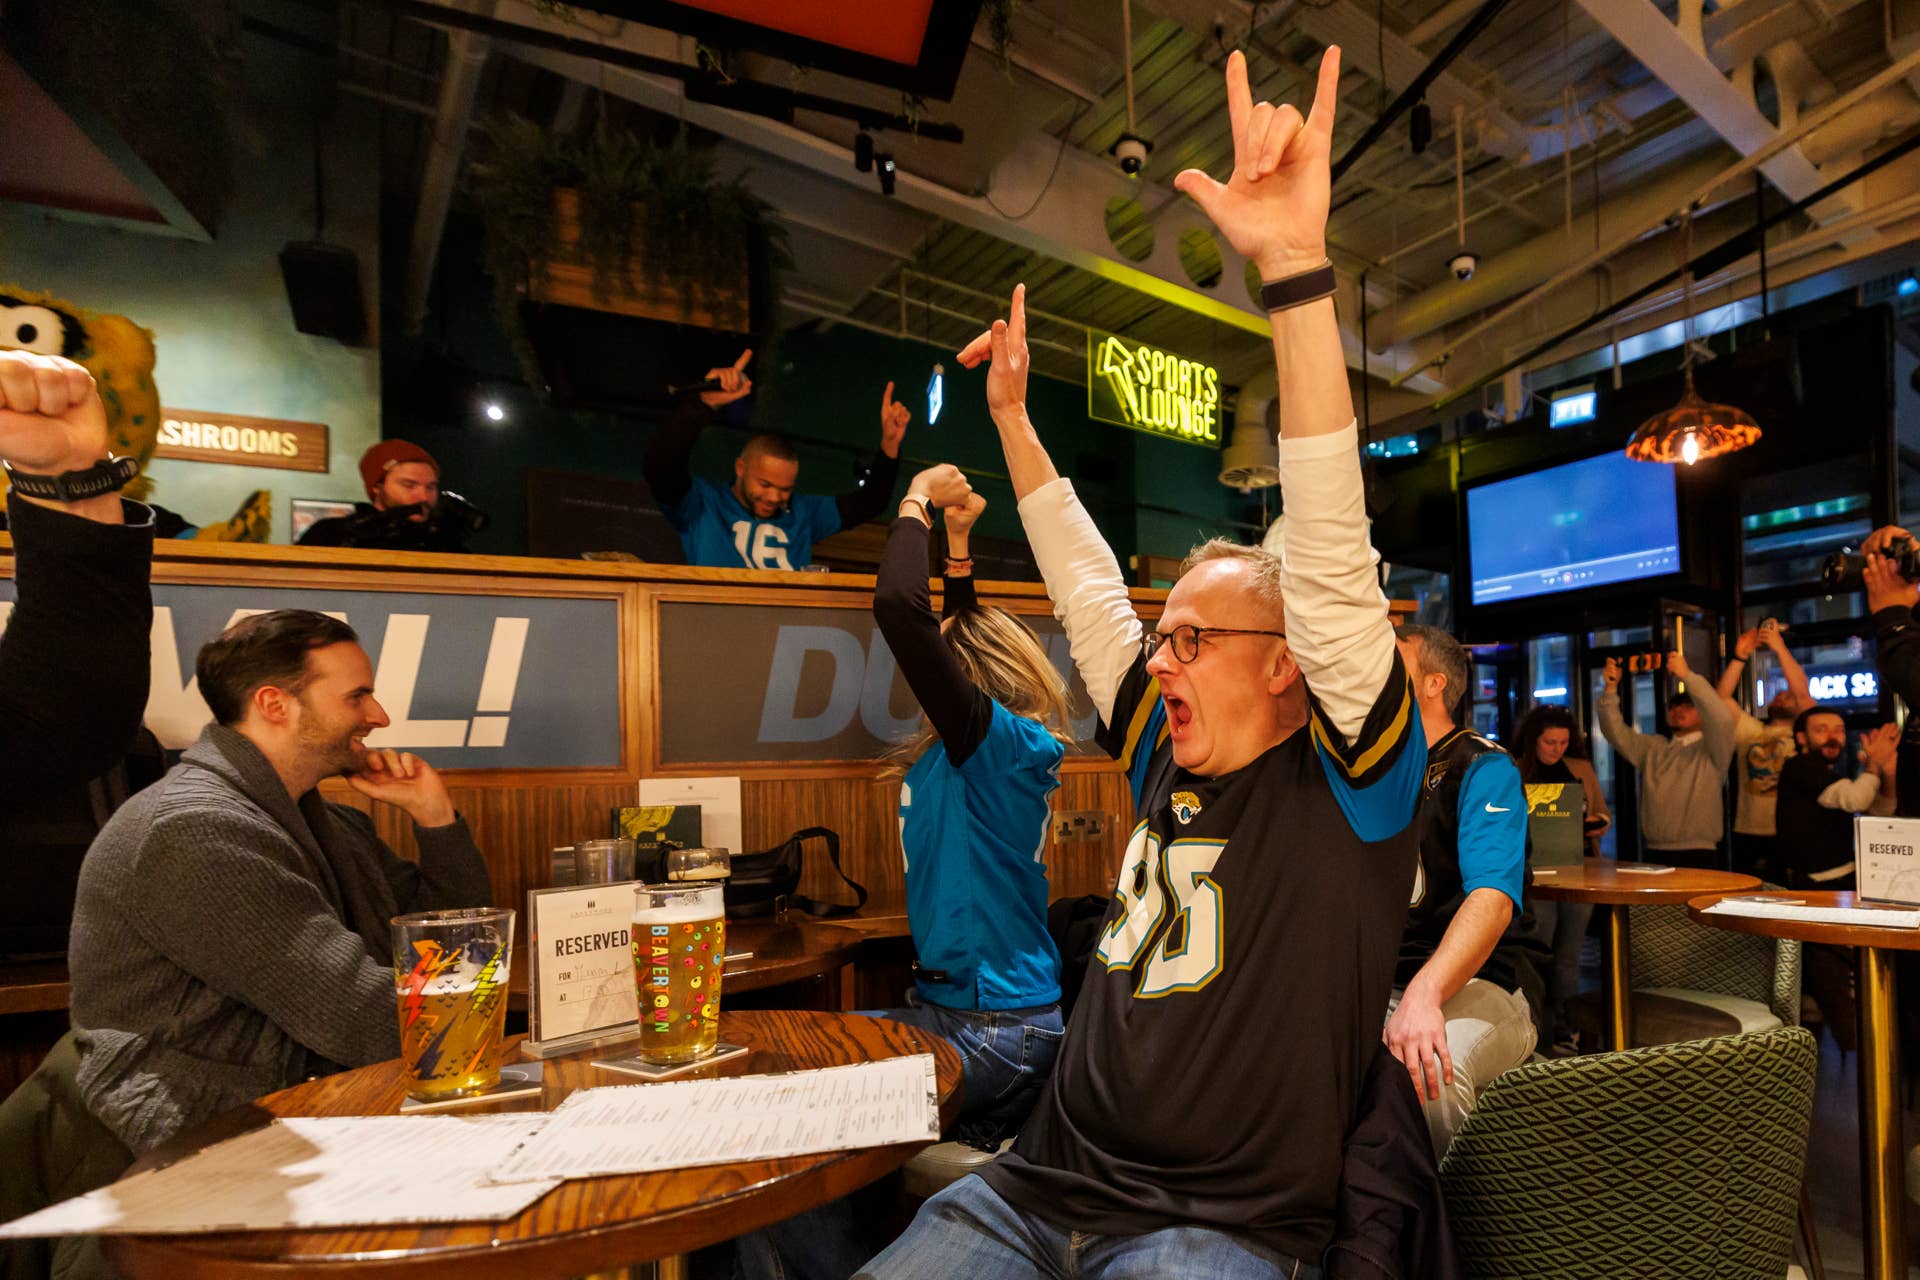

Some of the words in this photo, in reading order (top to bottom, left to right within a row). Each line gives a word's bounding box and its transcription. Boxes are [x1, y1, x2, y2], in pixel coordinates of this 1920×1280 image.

[1137, 346, 1218, 403] SPORTS
[1139, 385, 1217, 441] LOUNGE
[157, 419, 298, 457] SHROOMS
[732, 520, 795, 571] 16
[1808, 675, 1848, 699] ACK
[1869, 843, 1913, 856] RESERVED
[555, 929, 629, 957] RESERVED
[558, 971, 572, 981] FOR
[651, 926, 670, 1033] BEAVERTOWN
[559, 993, 567, 1001] AT
